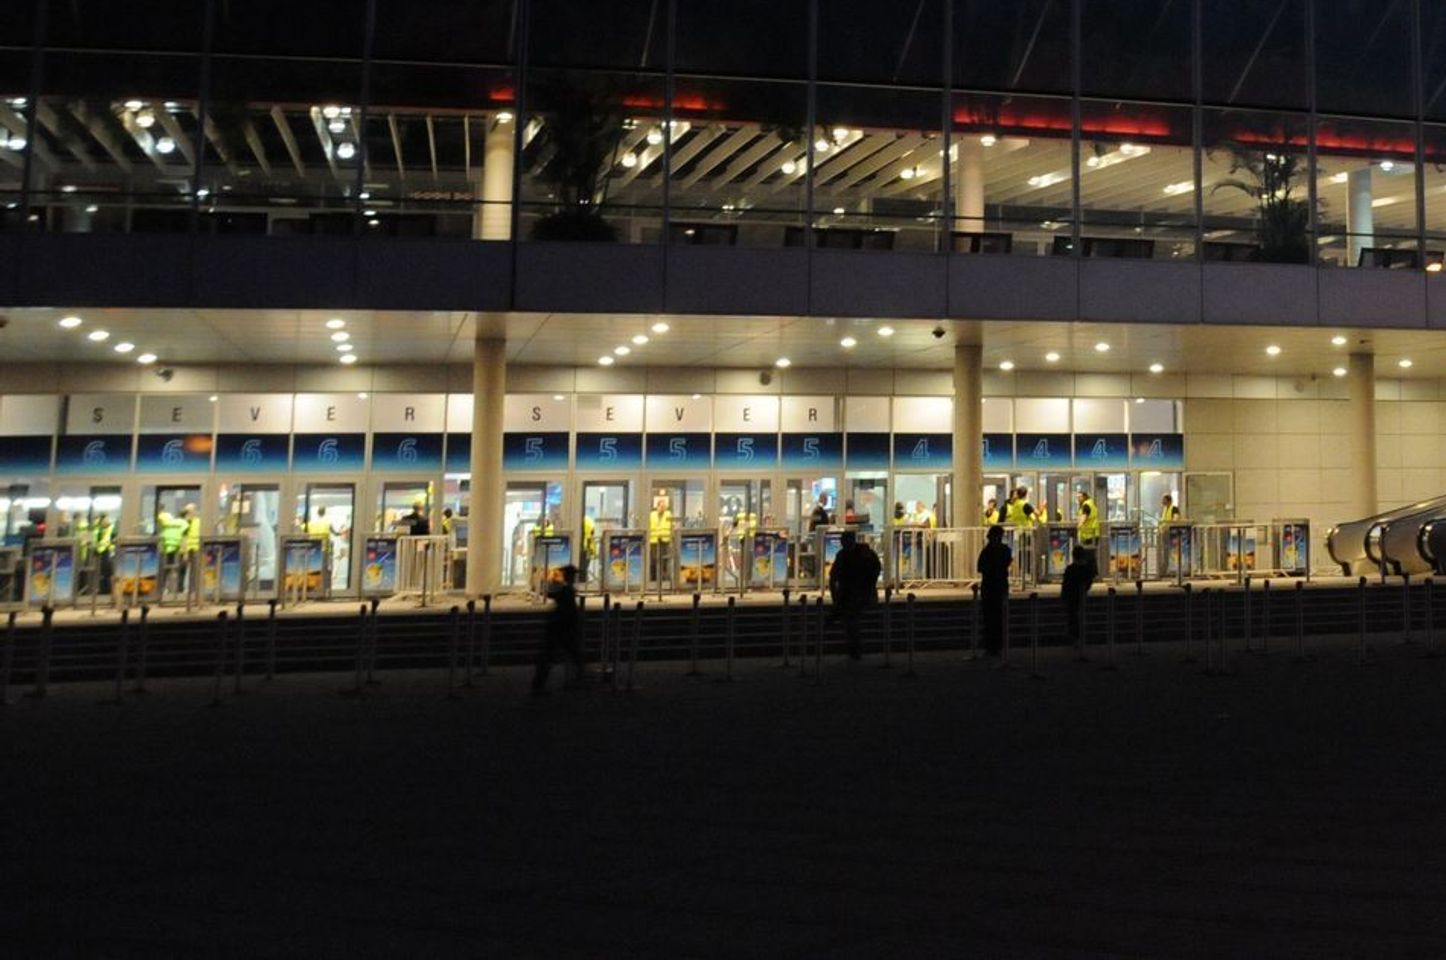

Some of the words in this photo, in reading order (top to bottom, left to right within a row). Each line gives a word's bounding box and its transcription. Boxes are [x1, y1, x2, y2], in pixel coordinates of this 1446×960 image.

[525, 438, 544, 465] 5
[600, 437, 618, 464] 5
[669, 437, 688, 463] 5
[737, 437, 755, 464] 5
[803, 437, 821, 462] 5
